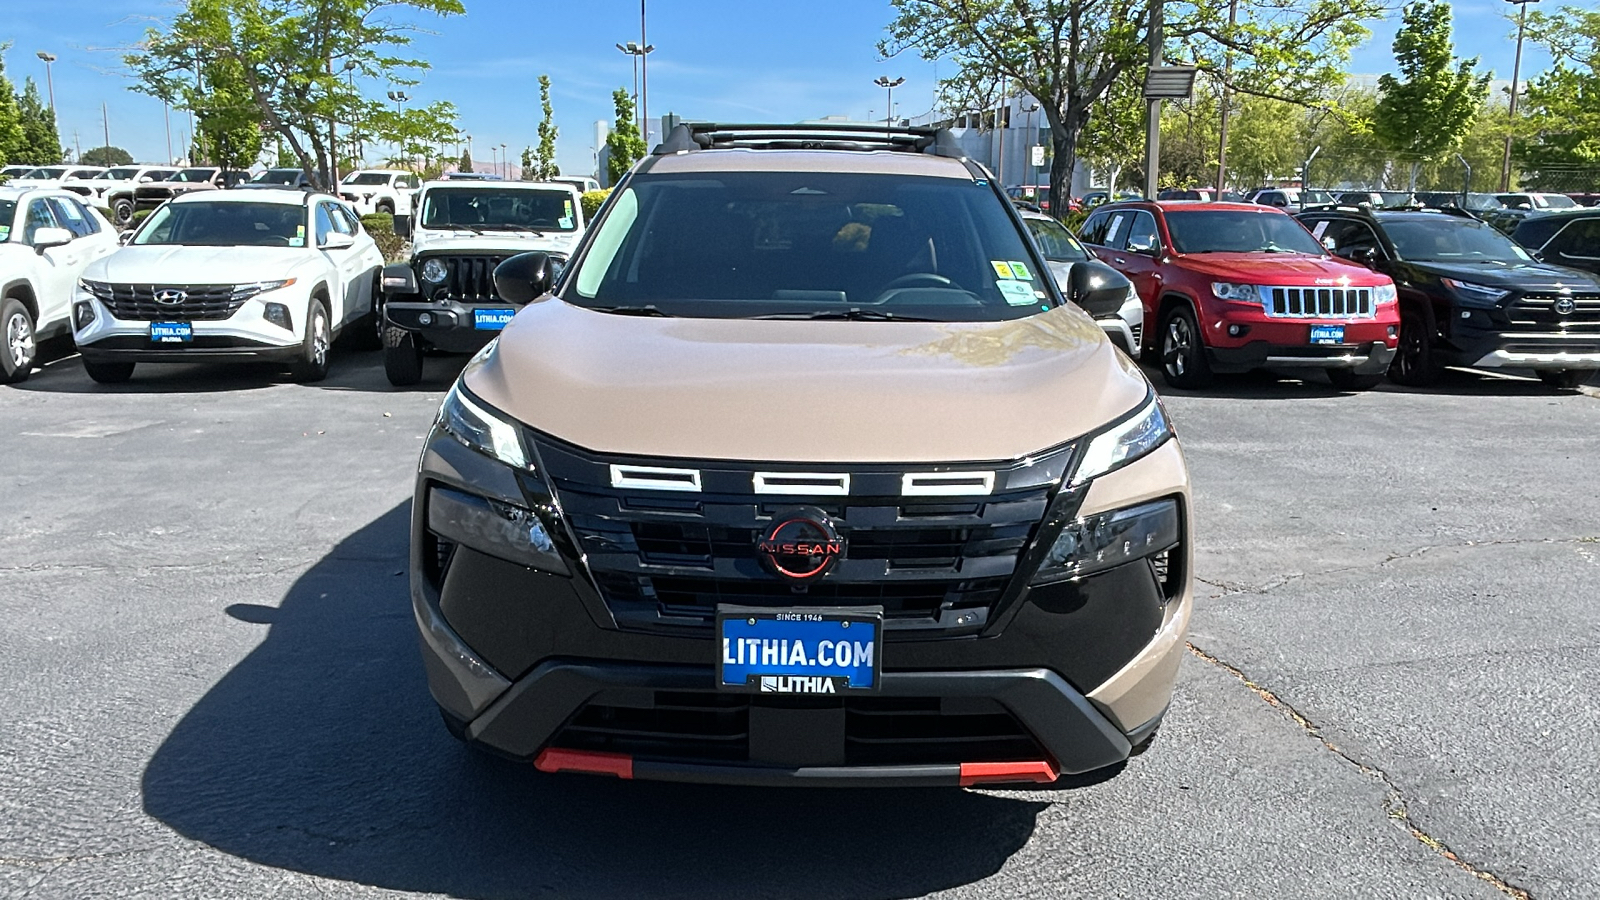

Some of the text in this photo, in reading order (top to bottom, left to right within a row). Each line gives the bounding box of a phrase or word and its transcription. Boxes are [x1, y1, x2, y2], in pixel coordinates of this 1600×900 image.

[760, 541, 840, 555] NISSAN
[776, 613, 823, 622] SINCE 1946
[723, 638, 874, 667] LITHIA.COM
[777, 676, 836, 694] LITHIA
